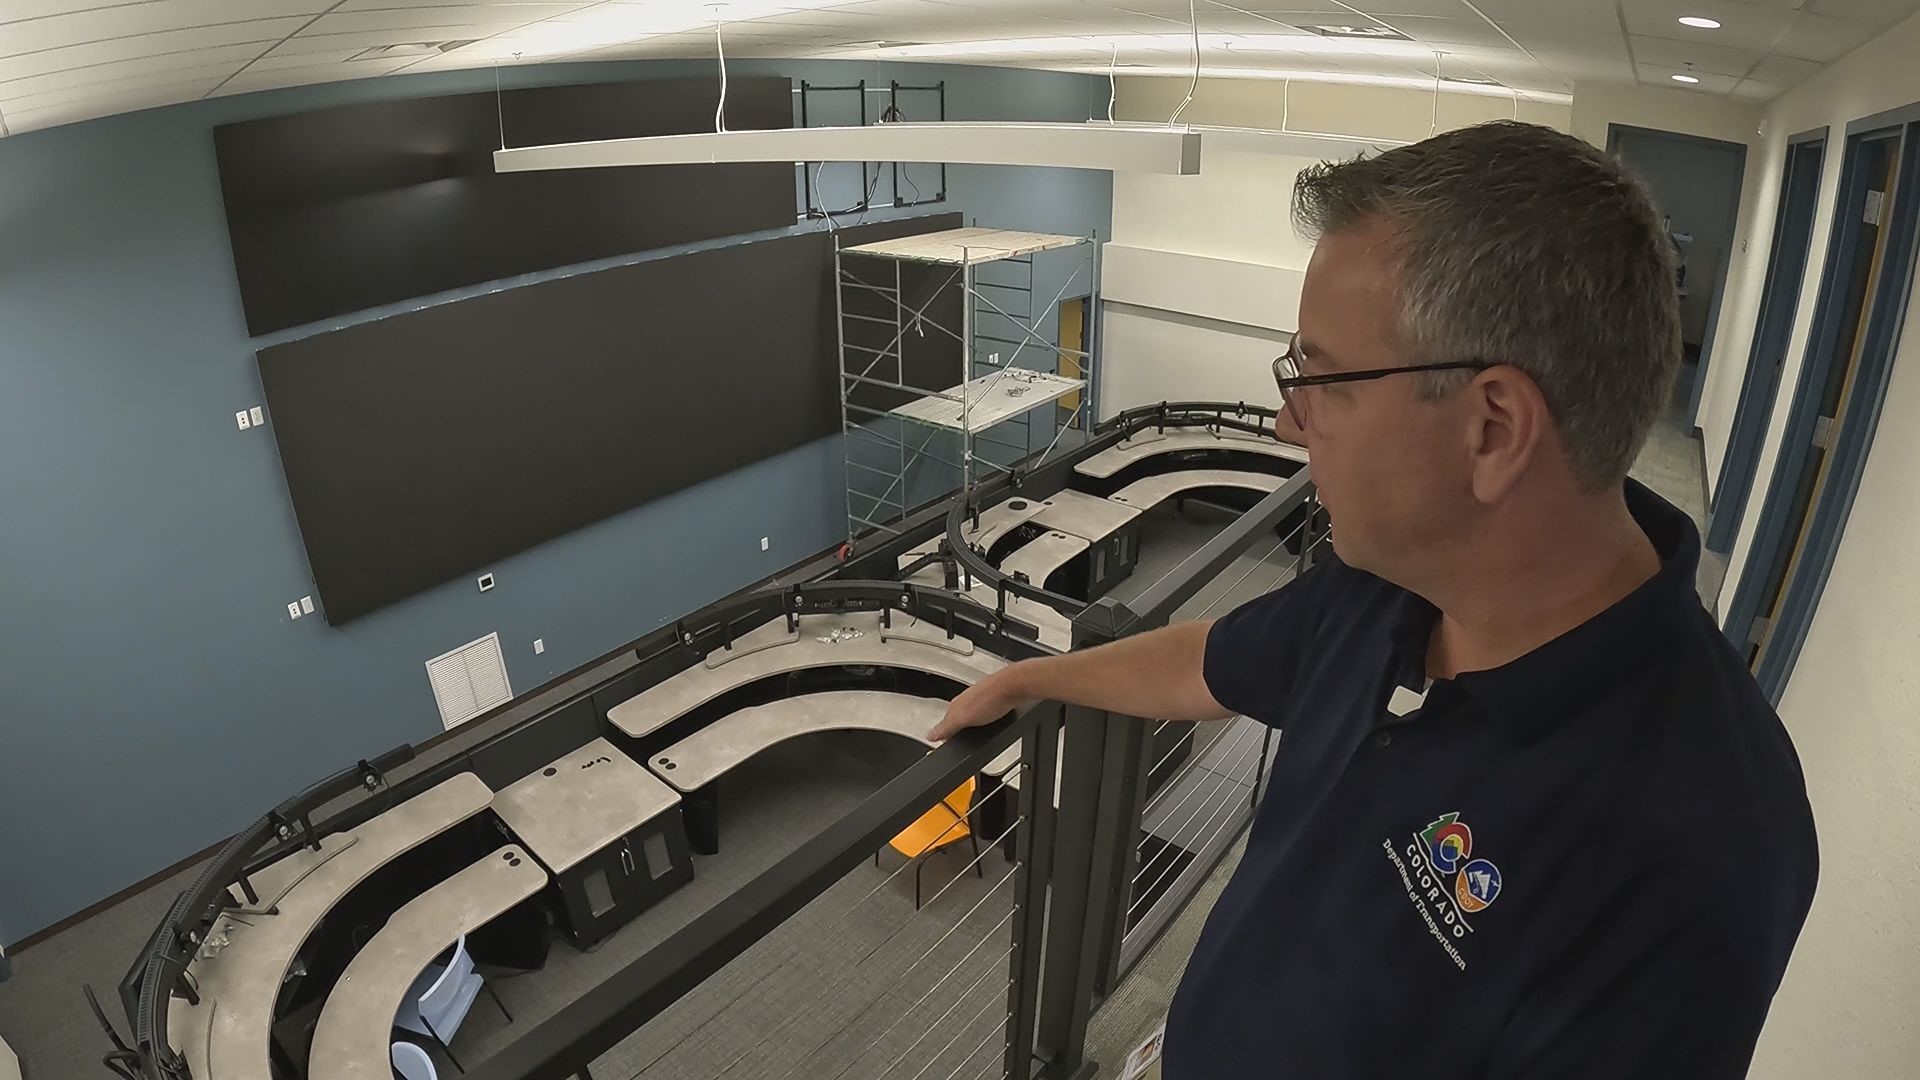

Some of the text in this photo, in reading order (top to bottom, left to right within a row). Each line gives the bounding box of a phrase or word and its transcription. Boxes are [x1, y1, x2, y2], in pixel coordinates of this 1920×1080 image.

[1382, 838, 1467, 971] Department of Transportation
[1406, 844, 1465, 938] COLORADO
[1458, 887, 1474, 909] CDOT
